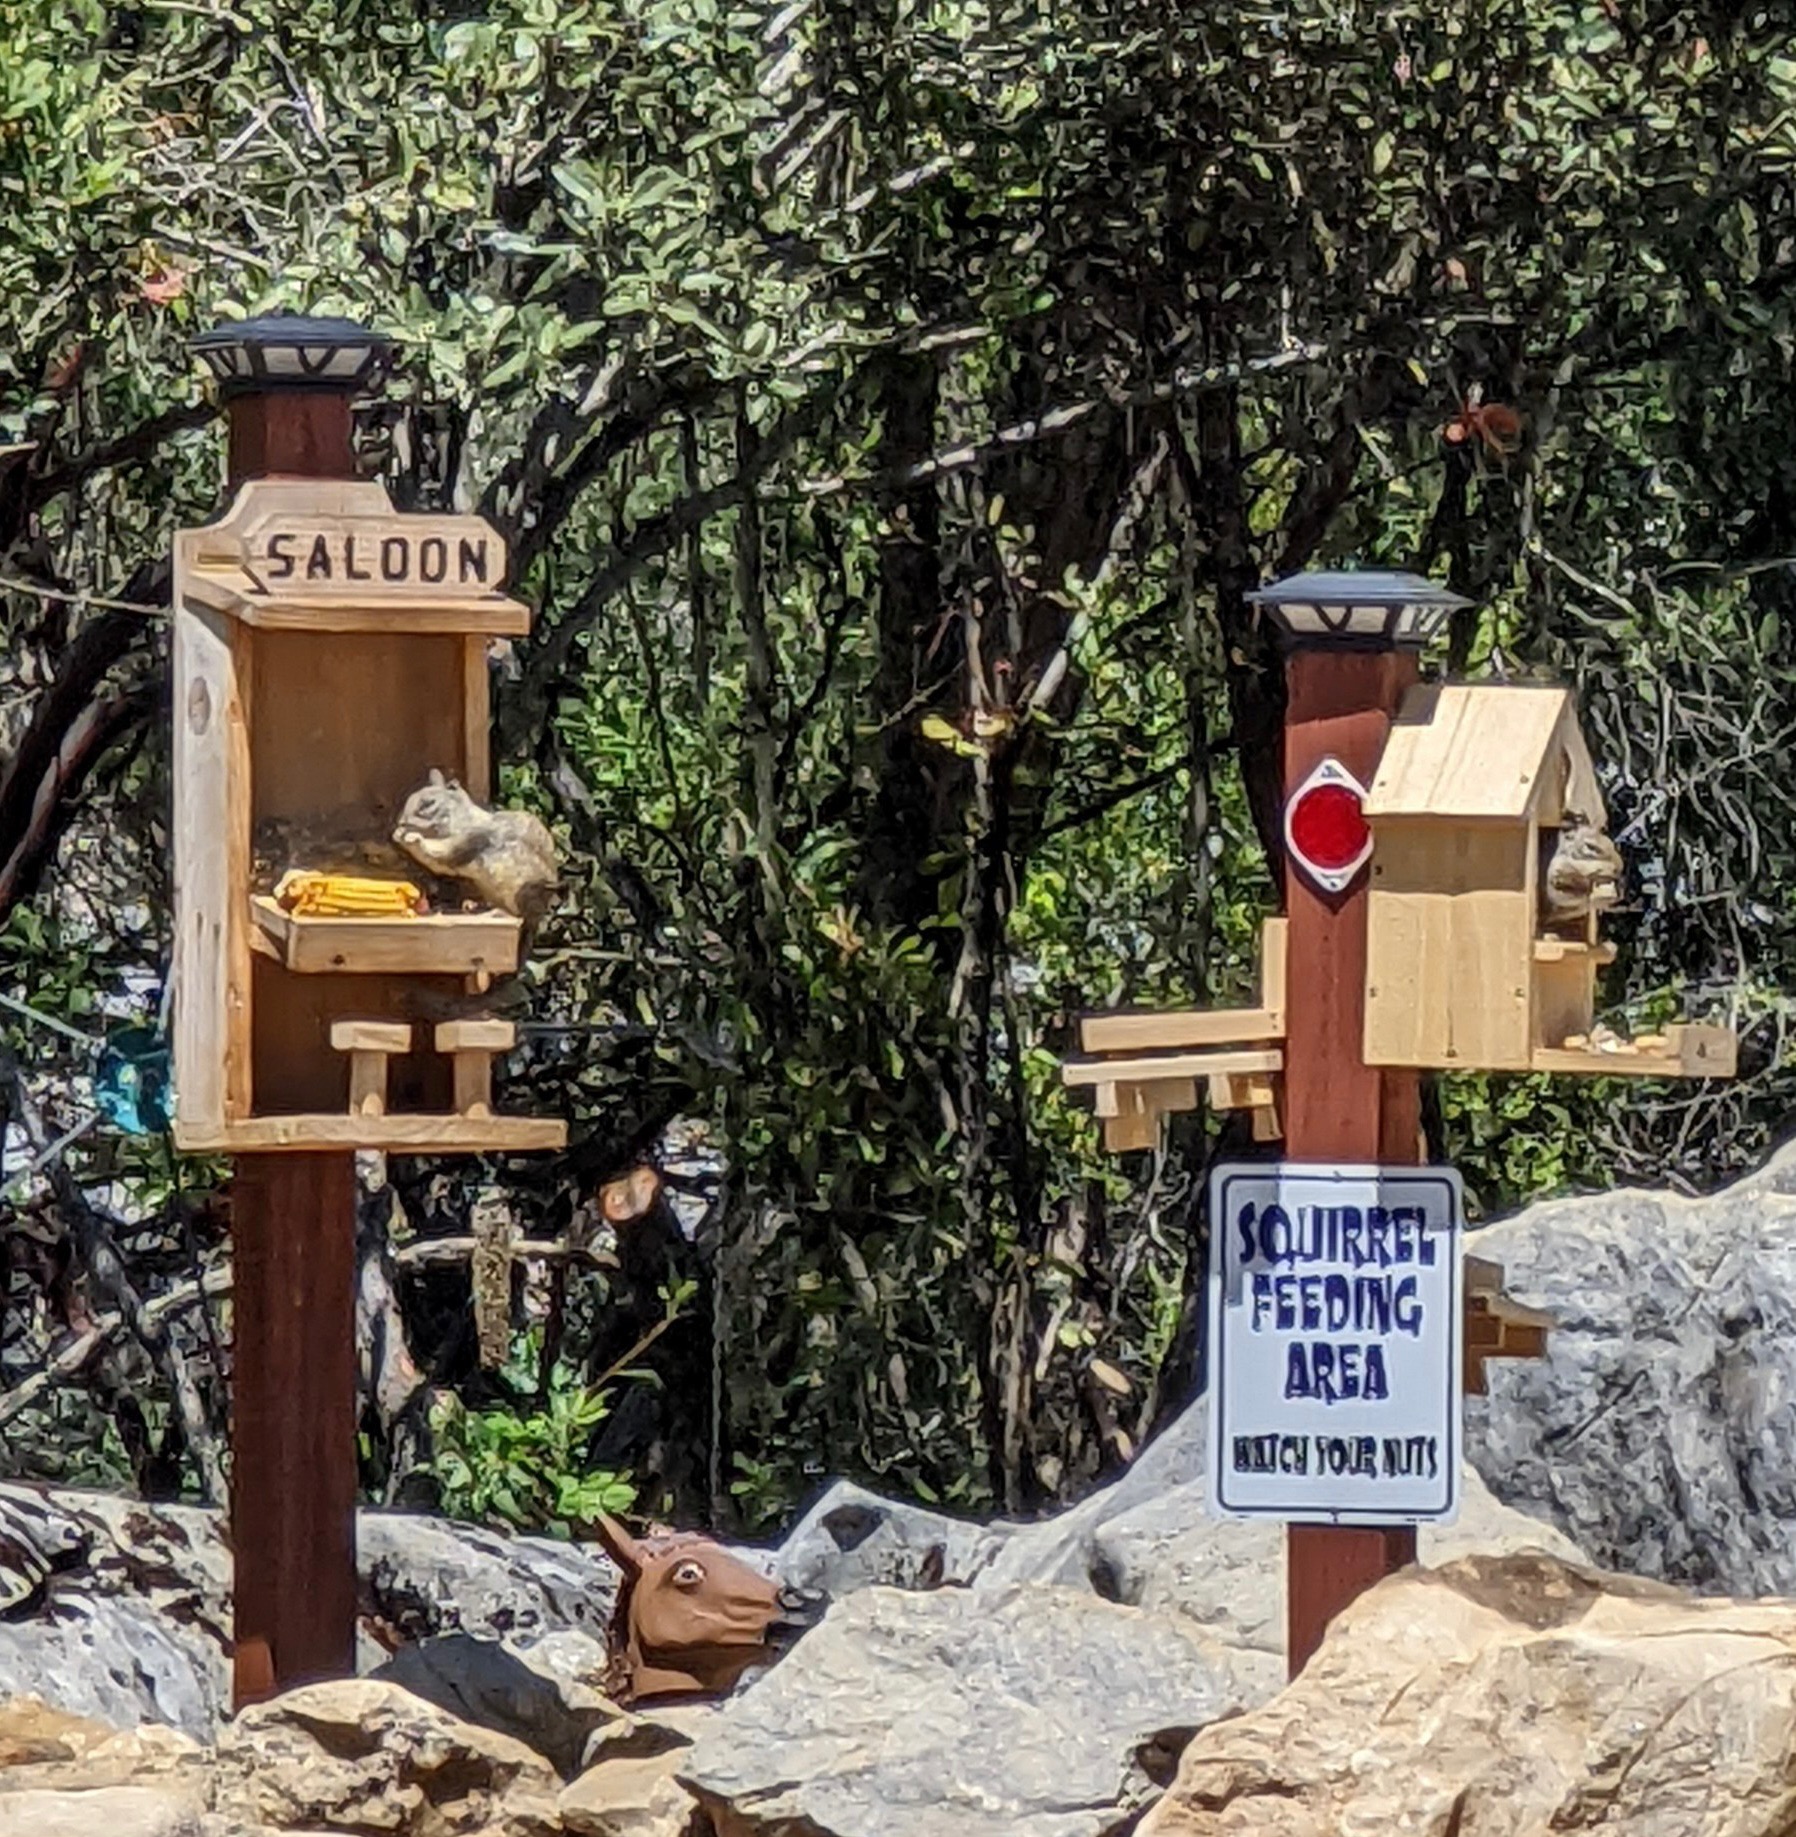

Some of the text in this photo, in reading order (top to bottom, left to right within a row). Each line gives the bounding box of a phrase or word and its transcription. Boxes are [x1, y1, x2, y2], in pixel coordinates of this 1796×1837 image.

[267, 533, 488, 583] SALOON
[1238, 1201, 1436, 1267] SQUIRREL
[1251, 1274, 1423, 1336] FEEDING
[1284, 1341, 1389, 1404] AREA
[1315, 1436, 1377, 1479] YOUR
[1383, 1436, 1438, 1479] NUTS
